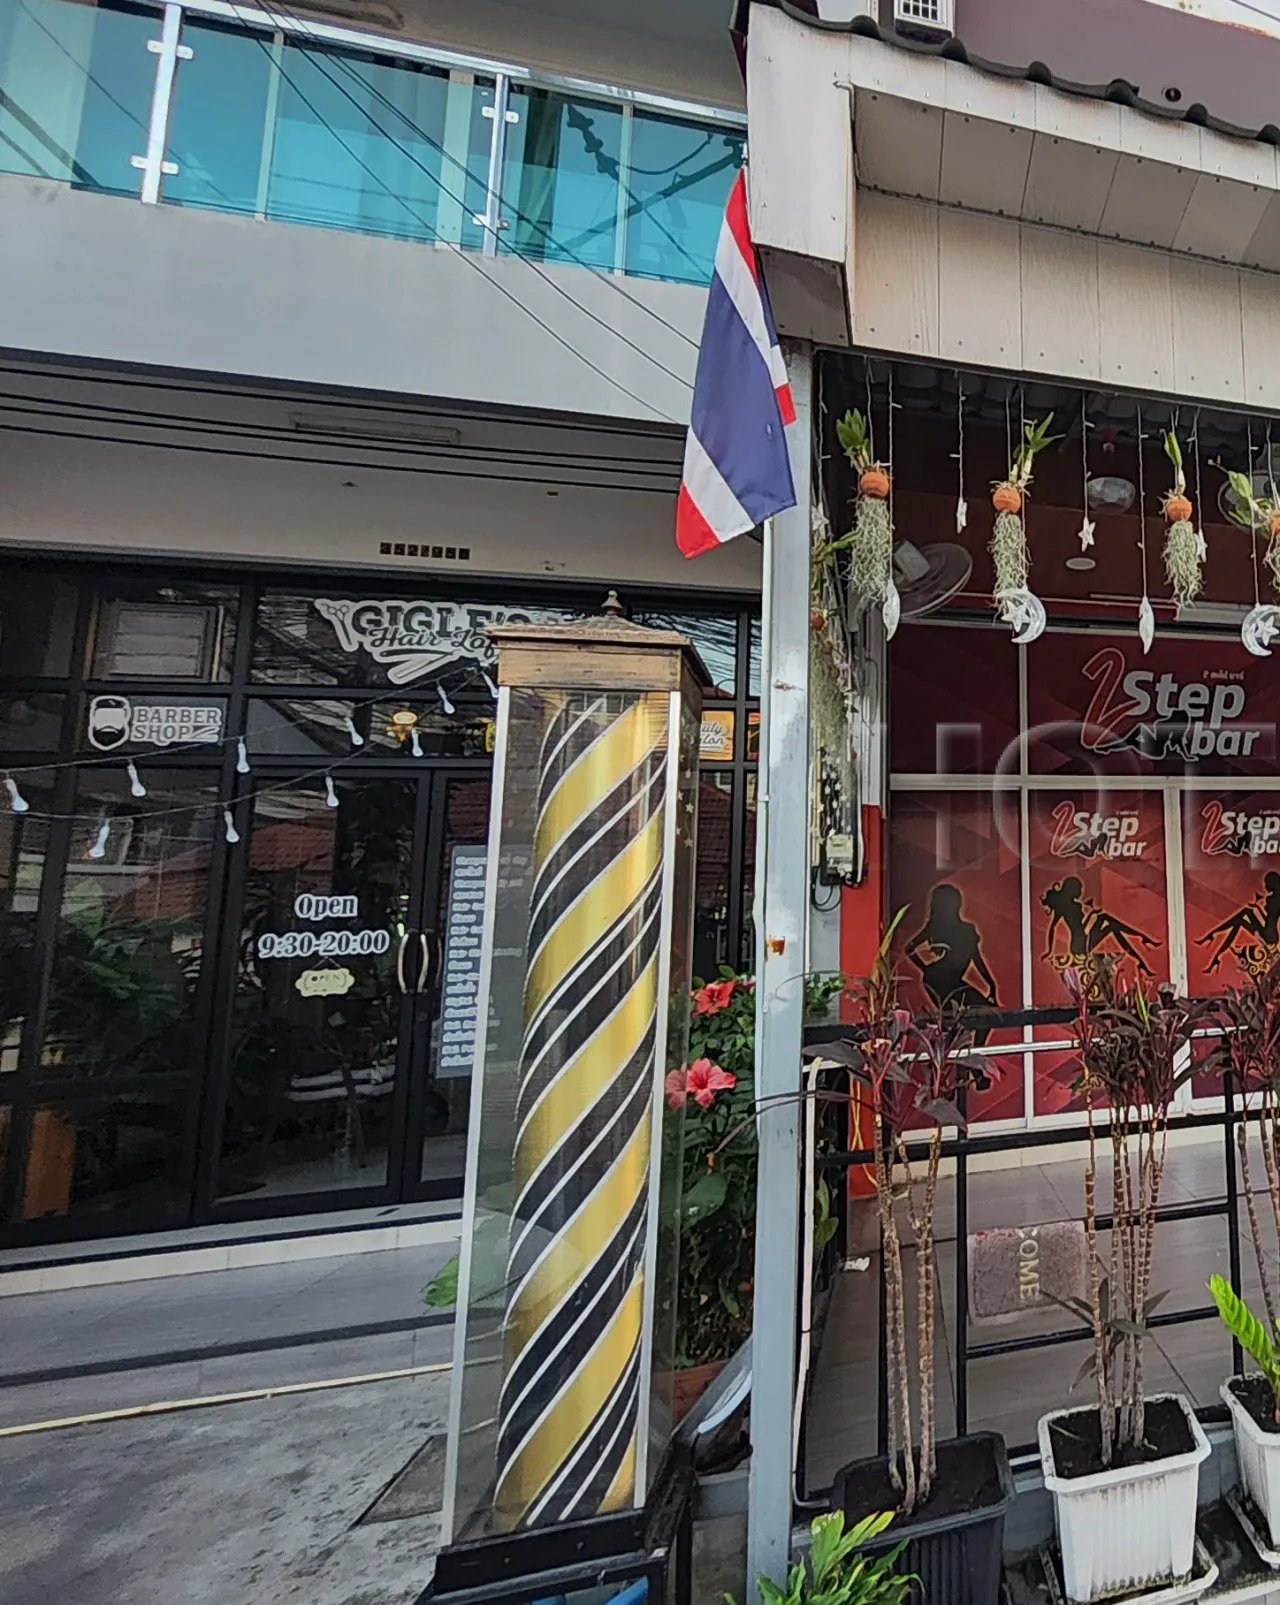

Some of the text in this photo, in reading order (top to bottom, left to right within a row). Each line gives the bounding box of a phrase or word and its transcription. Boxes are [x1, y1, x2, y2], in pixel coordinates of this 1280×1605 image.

[369, 626, 442, 648] Hair
[137, 708, 218, 723] BARBER
[133, 724, 191, 743] SHOP
[1190, 721, 1260, 756] bar
[1108, 837, 1148, 857] bar
[297, 894, 358, 918] Open
[259, 930, 390, 957] 9:30-20:00
